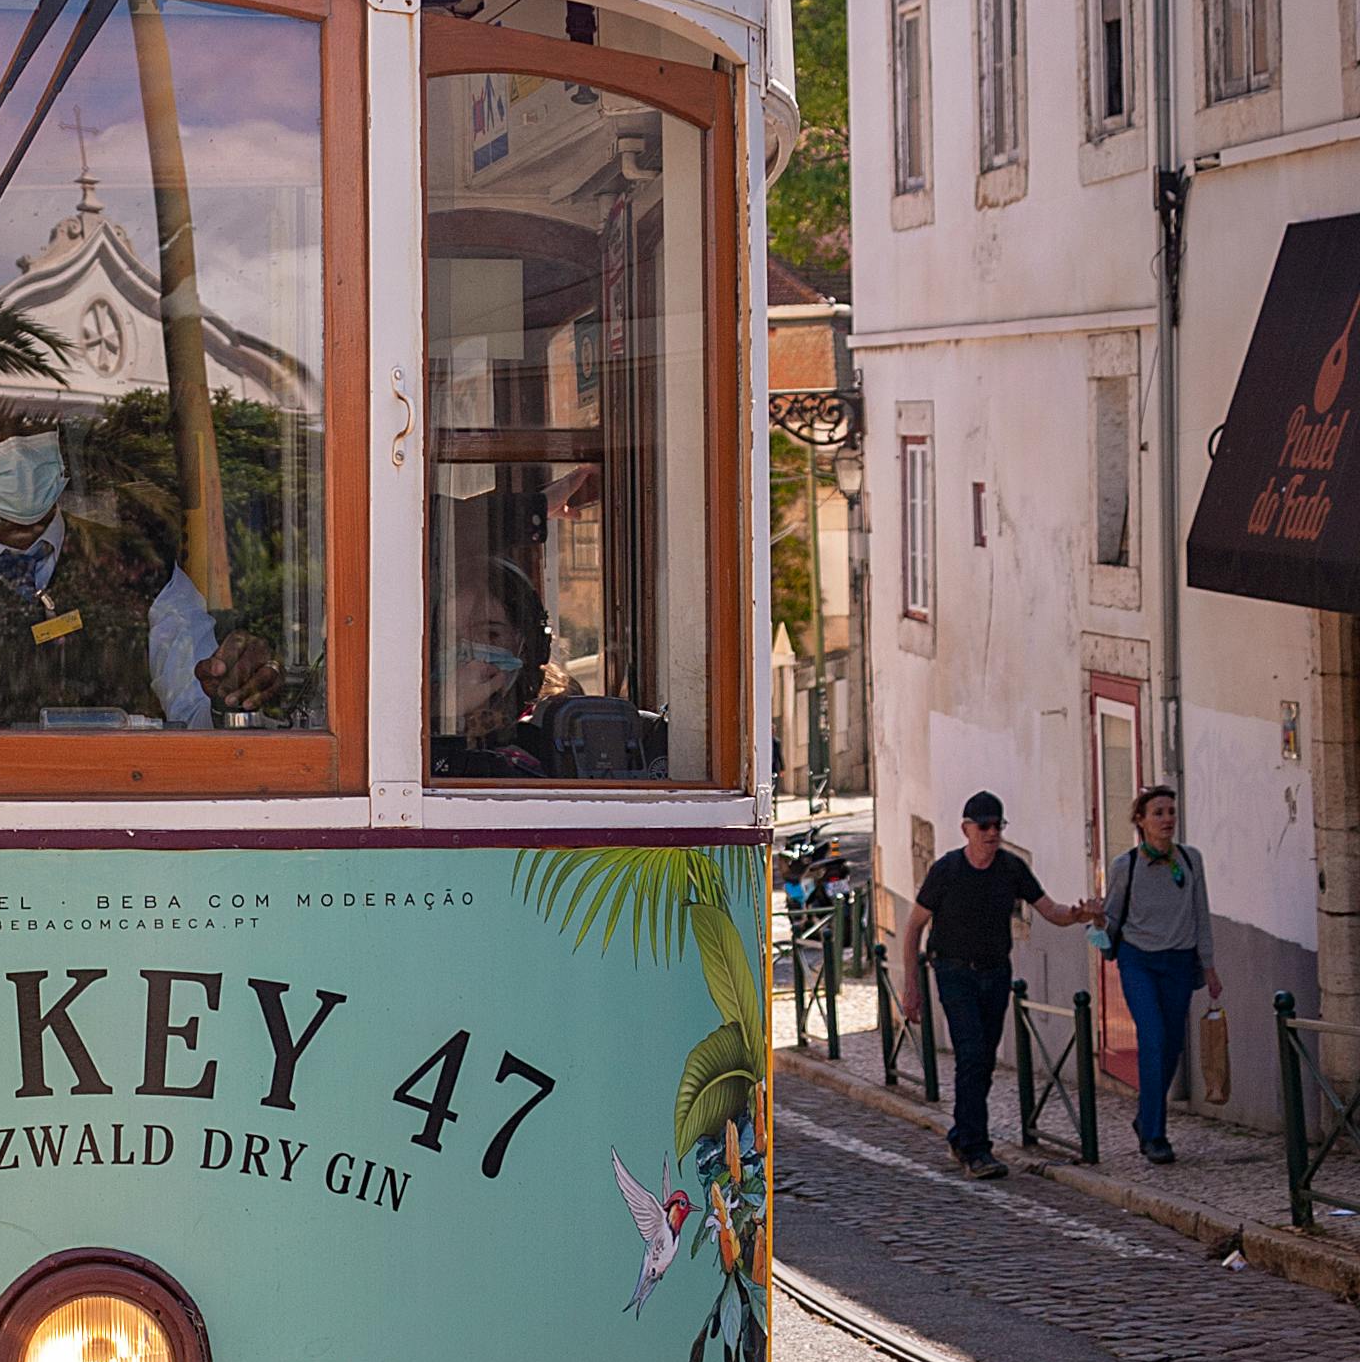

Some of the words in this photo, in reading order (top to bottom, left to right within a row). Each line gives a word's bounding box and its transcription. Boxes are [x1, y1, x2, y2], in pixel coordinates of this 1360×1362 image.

[1279, 404, 1350, 470] Pastel
[1247, 476, 1280, 535] do
[1275, 473, 1333, 541] Fado
[96, 894, 182, 910] BEBA
[208, 893, 270, 909] COM
[297, 888, 474, 911] MODERAÇÃO
[392, 1029, 557, 1180] 47
[199, 1127, 310, 1182] DRY
[325, 1152, 413, 1213] GIN
